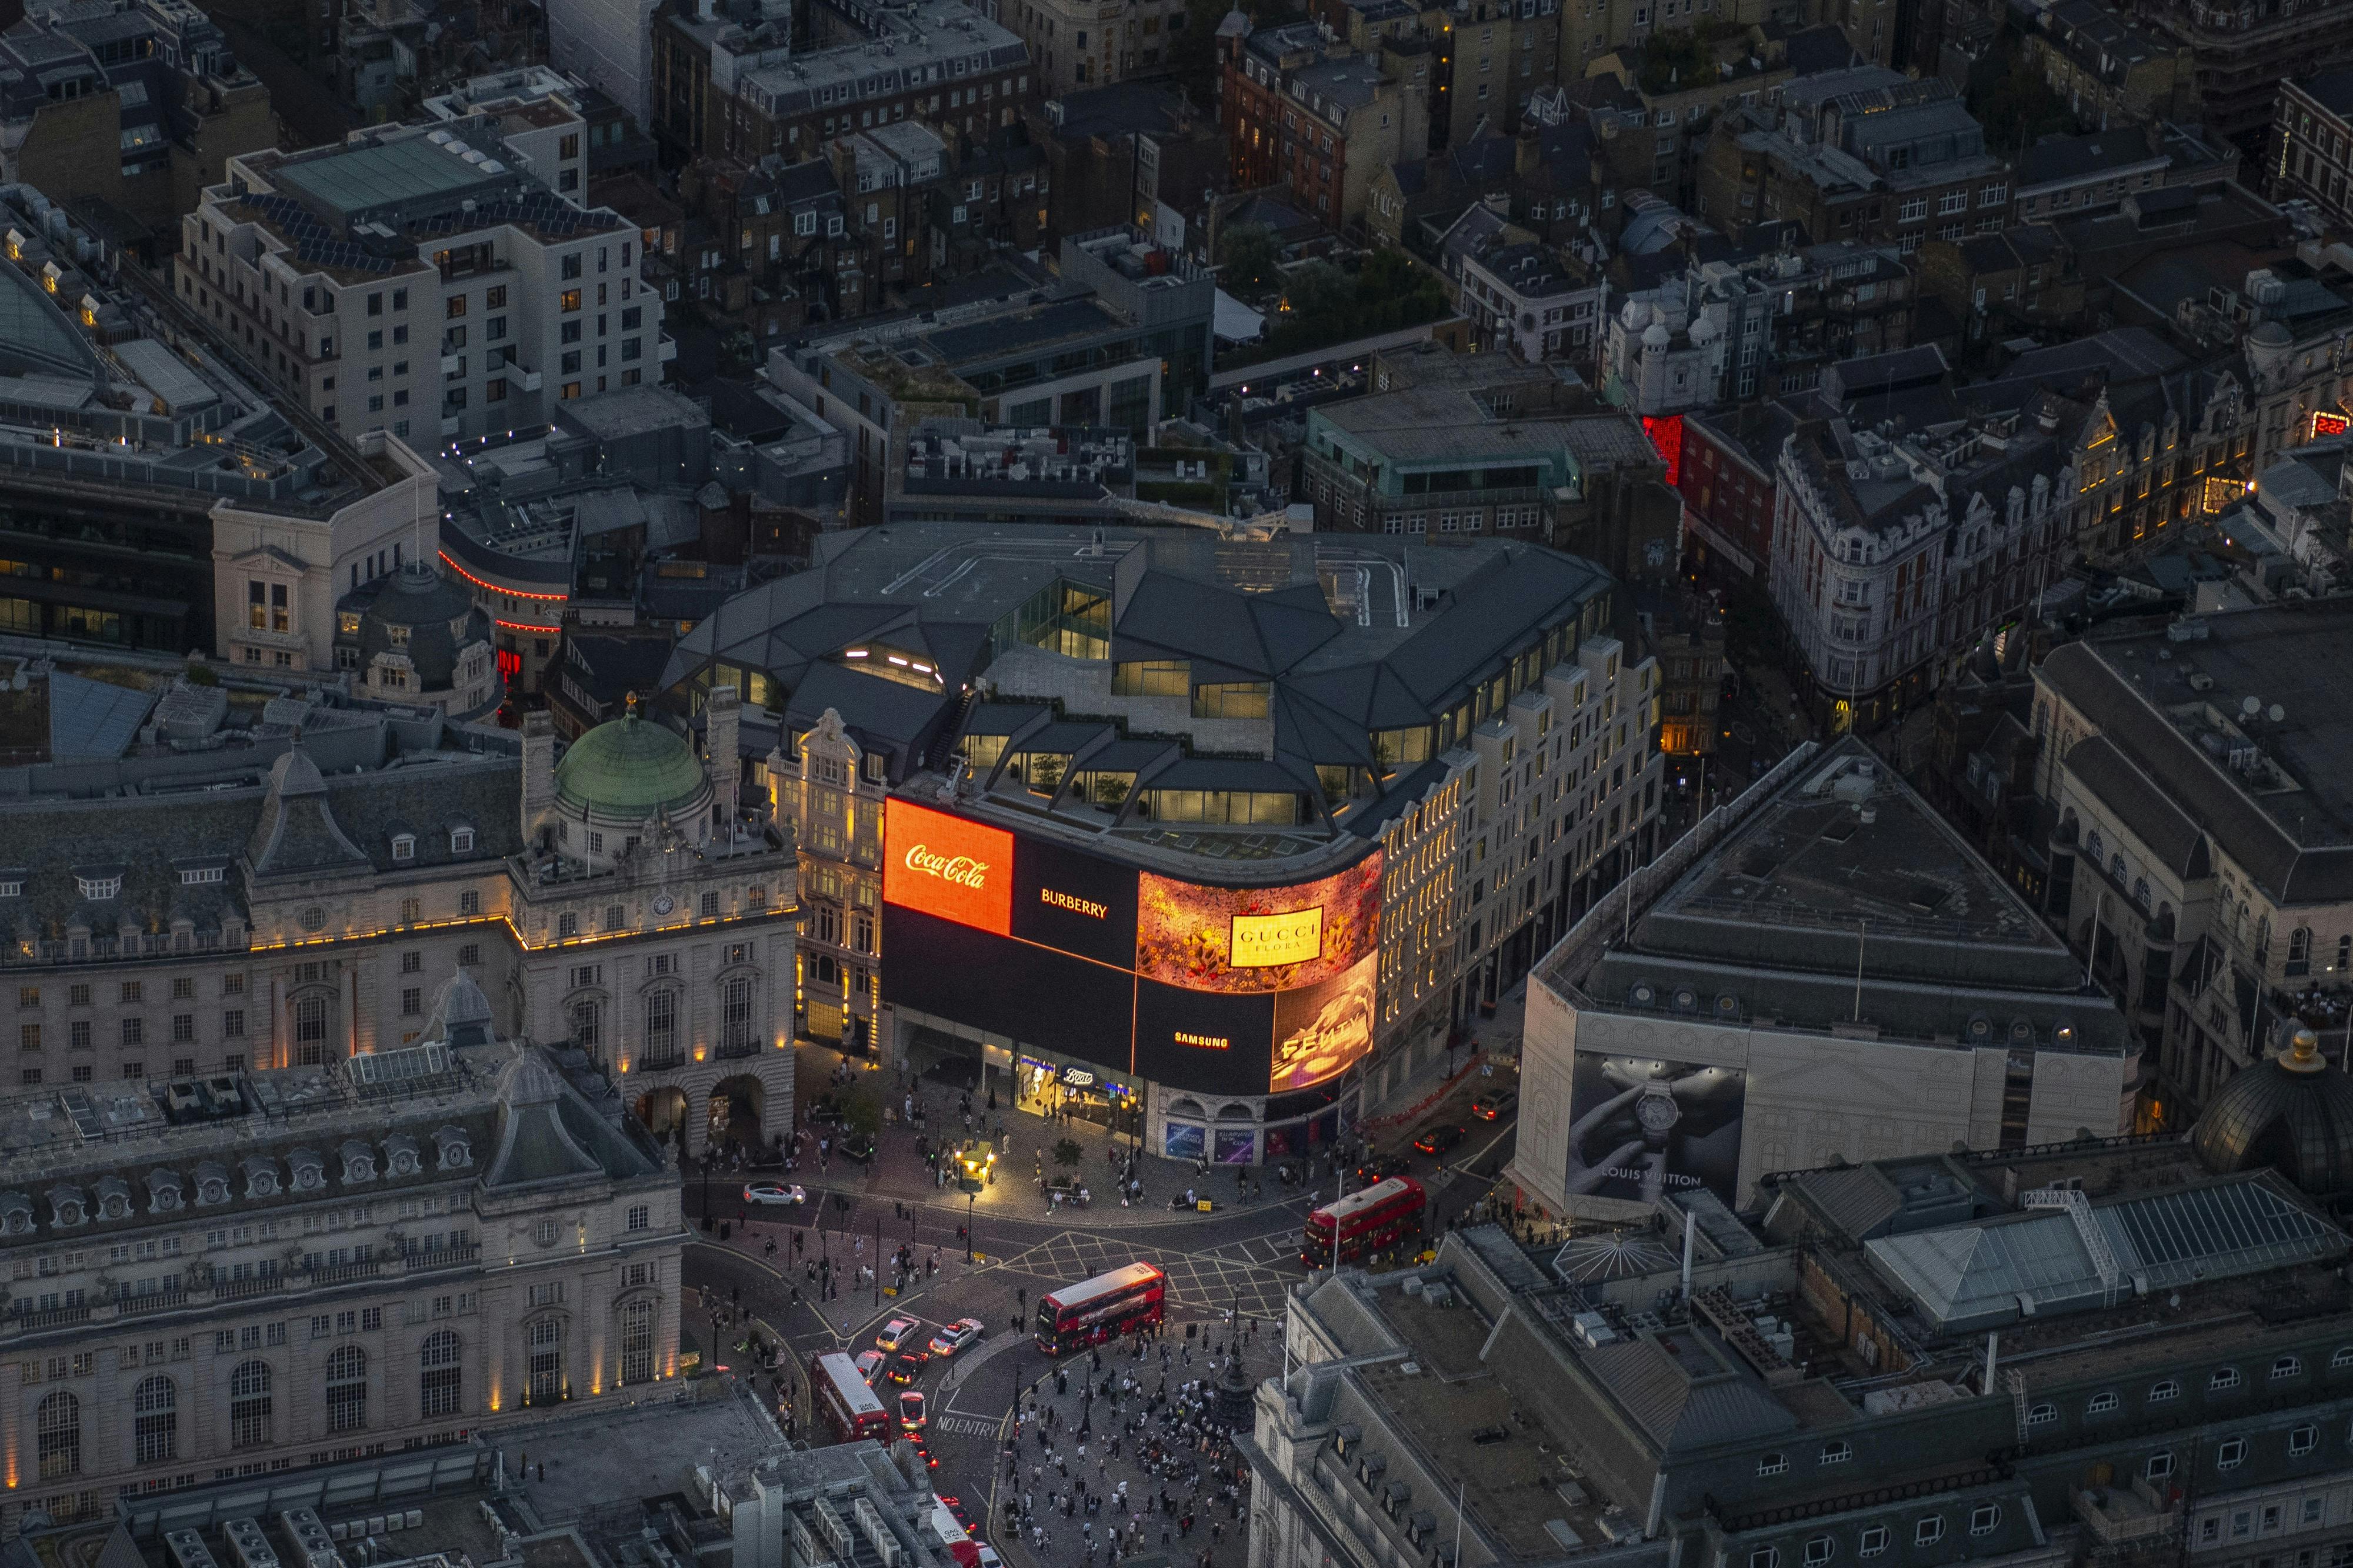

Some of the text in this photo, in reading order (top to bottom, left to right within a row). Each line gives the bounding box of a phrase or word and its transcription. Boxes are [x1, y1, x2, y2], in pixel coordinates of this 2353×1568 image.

[2318, 418, 2345, 435] 2:22
[905, 844, 989, 889] Coca-Cola
[1042, 888, 1107, 919] BURBERRY
[1241, 924, 1314, 943] GUCCI
[1256, 942, 1300, 952] FLORA
[1175, 1032, 1228, 1047] SAMSUNG
[1281, 1012, 1359, 1060] FENTY
[1063, 1067, 1093, 1086] Boots
[1601, 1166, 1641, 1180] LOUIS
[1644, 1171, 1701, 1187] VUITTON
[936, 1416, 999, 1437] NO ENTRY
